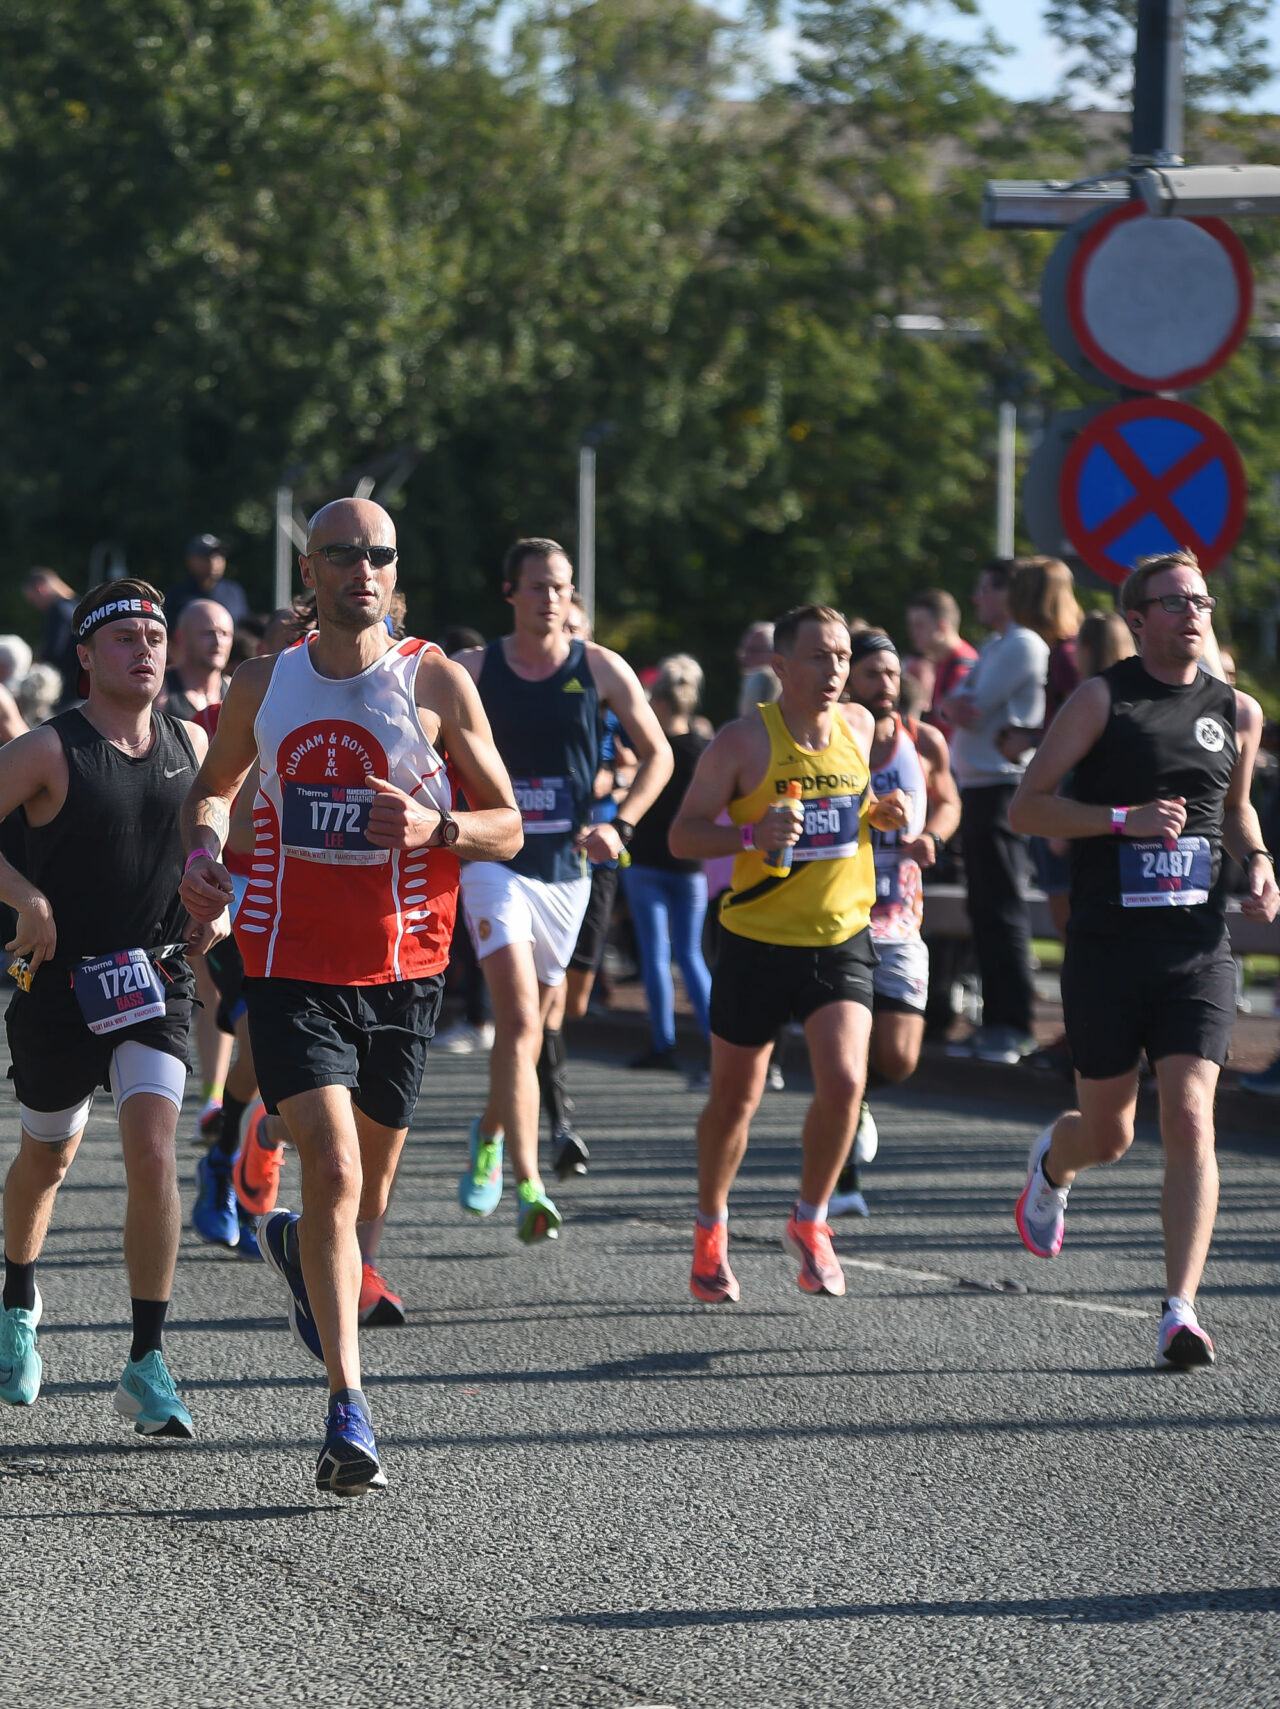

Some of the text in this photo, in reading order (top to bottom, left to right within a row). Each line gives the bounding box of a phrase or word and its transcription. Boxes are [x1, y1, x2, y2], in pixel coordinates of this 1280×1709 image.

[285, 733, 325, 776] OLDHAM
[329, 732, 337, 744] &
[327, 748, 336, 757] H
[327, 758, 336, 767] &
[324, 767, 339, 777] AC
[296, 787, 329, 798] Therme
[775, 774, 858, 795] BDFORD
[346, 795, 375, 804] MARATHO
[310, 801, 360, 832] 1772
[804, 809, 841, 835] 850
[324, 832, 344, 848] LEE
[1142, 851, 1194, 878] 2487
[82, 960, 113, 974] Therme
[98, 962, 151, 1000] 1720
[116, 991, 145, 1012] BASS
